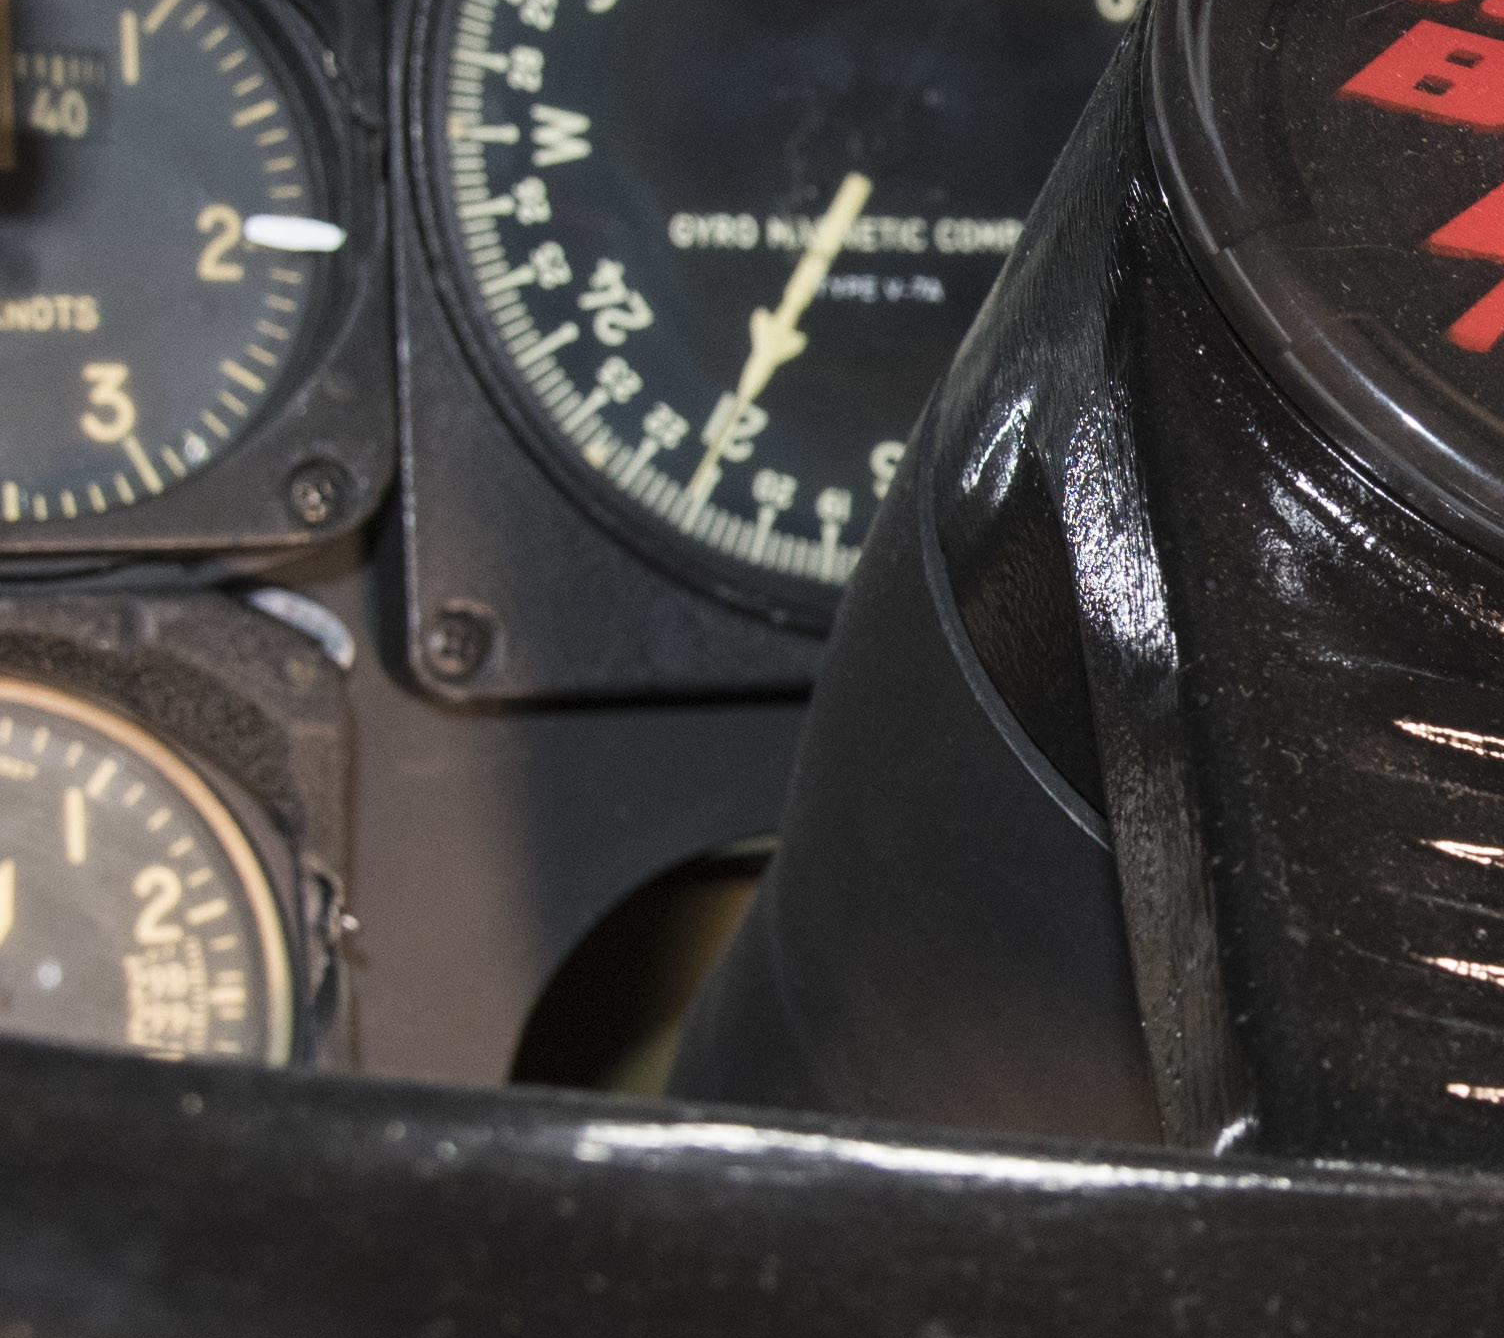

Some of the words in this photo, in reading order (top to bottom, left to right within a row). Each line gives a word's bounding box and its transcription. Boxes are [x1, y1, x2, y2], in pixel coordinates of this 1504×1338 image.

[29, 87, 90, 138] 40
[530, 102, 591, 168] W
[196, 203, 244, 282] 2
[668, 211, 760, 251] GYRO
[578, 257, 654, 347] 24
[81, 362, 135, 443] 3
[132, 865, 185, 945] 2
